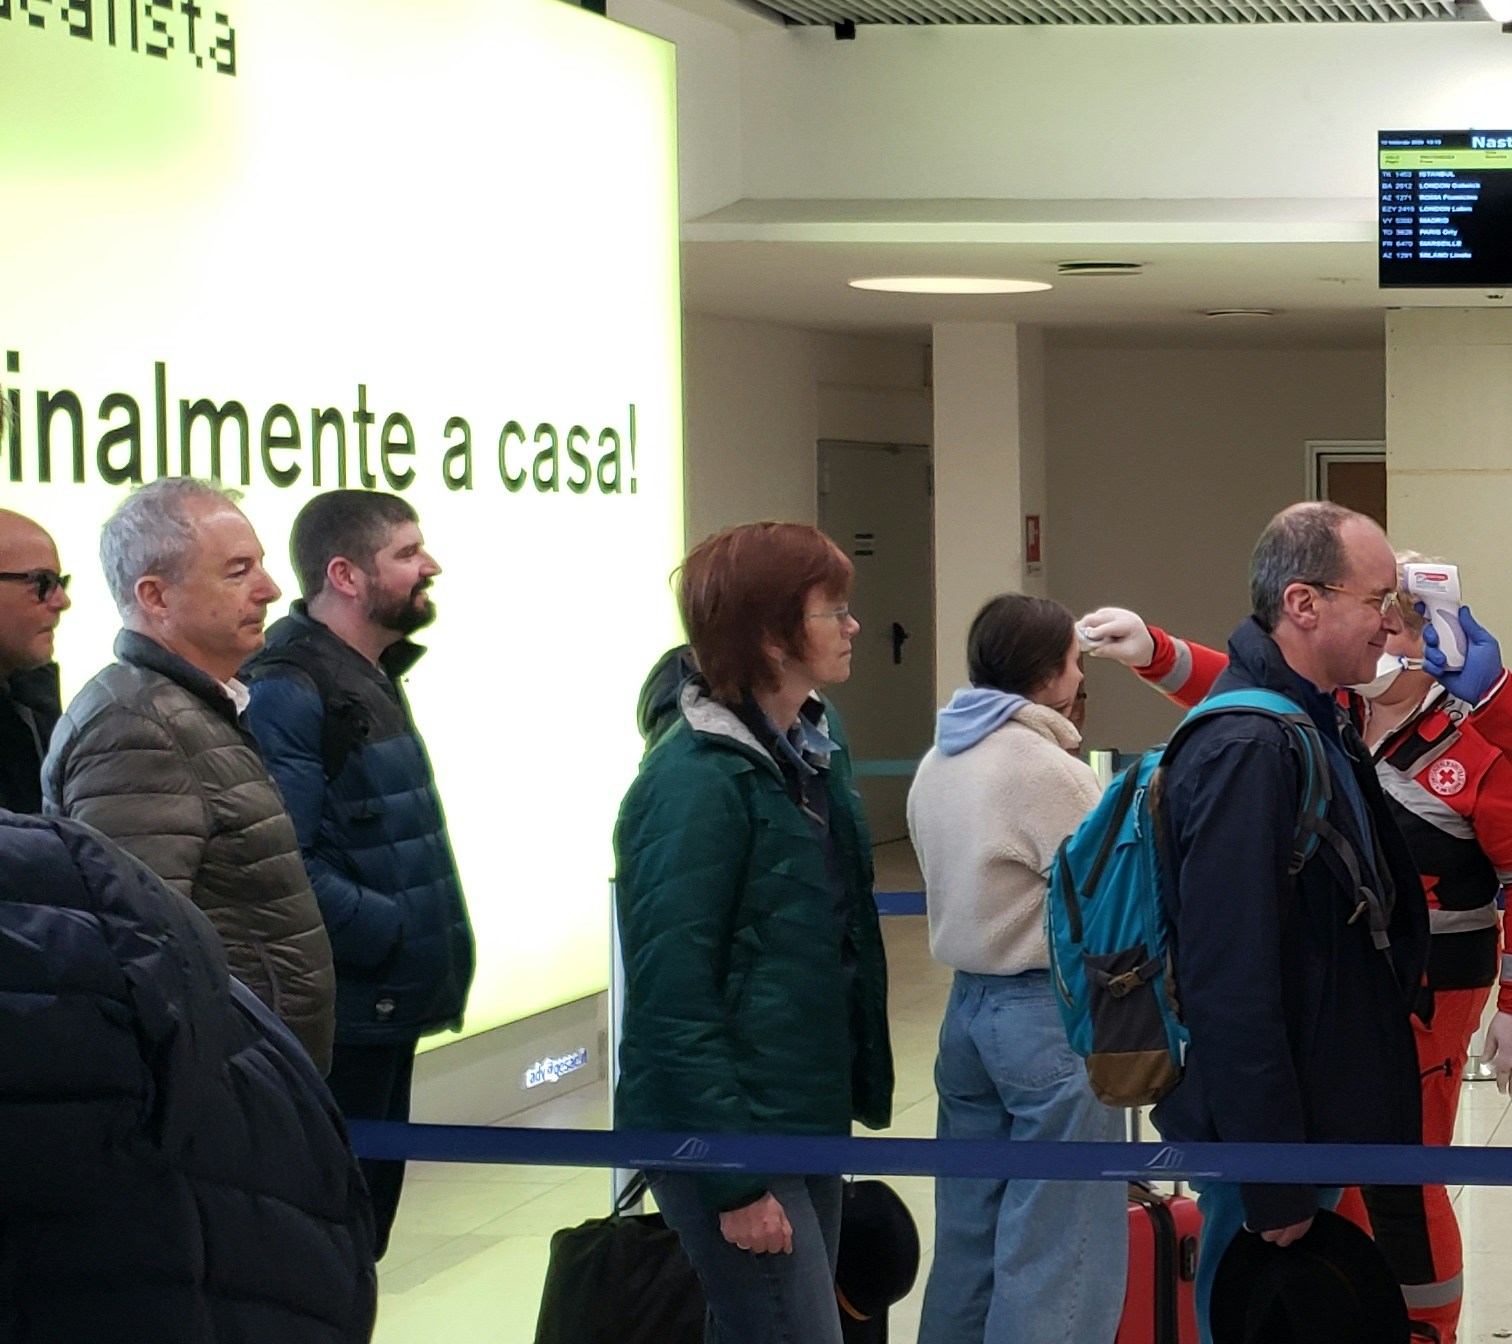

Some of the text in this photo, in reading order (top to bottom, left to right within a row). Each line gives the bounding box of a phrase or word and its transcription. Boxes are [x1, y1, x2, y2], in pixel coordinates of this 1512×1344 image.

[6, 350, 638, 495] inalmente a casa!
